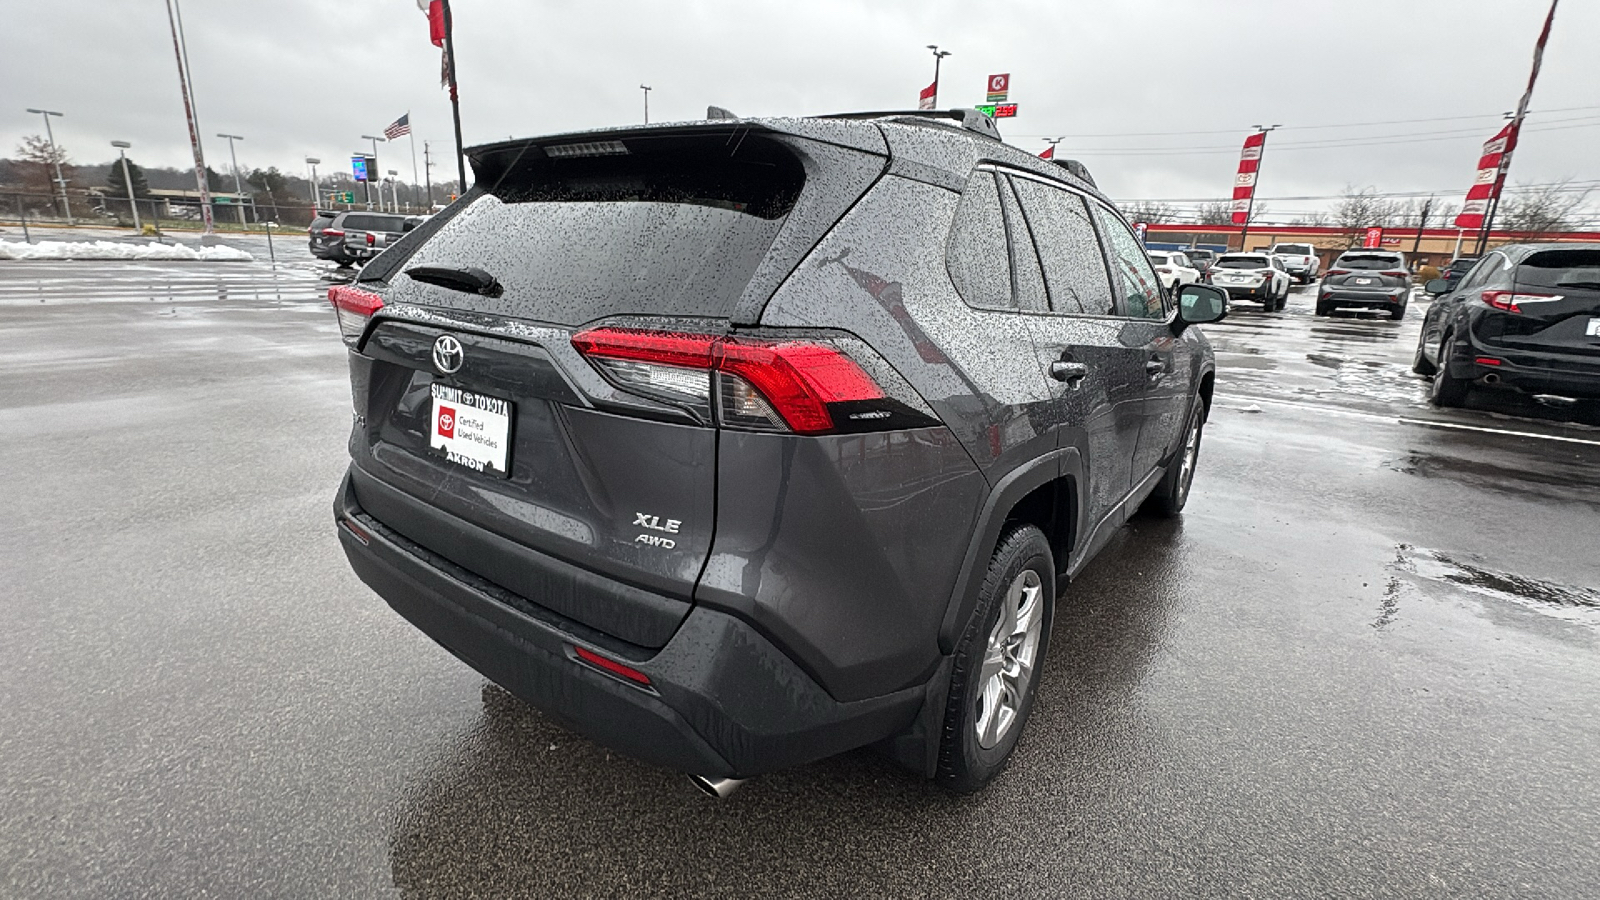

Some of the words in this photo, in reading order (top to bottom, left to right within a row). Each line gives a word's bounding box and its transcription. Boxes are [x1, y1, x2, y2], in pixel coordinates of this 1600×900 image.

[431, 383, 462, 404] SUMMIT
[474, 394, 509, 417] TOYOTA
[459, 416, 484, 431] Certified
[458, 427, 473, 441] Used
[473, 431, 498, 449] Vehicles
[445, 451, 484, 472] AKRON
[632, 511, 682, 533] XLE
[634, 534, 676, 549] AWD
